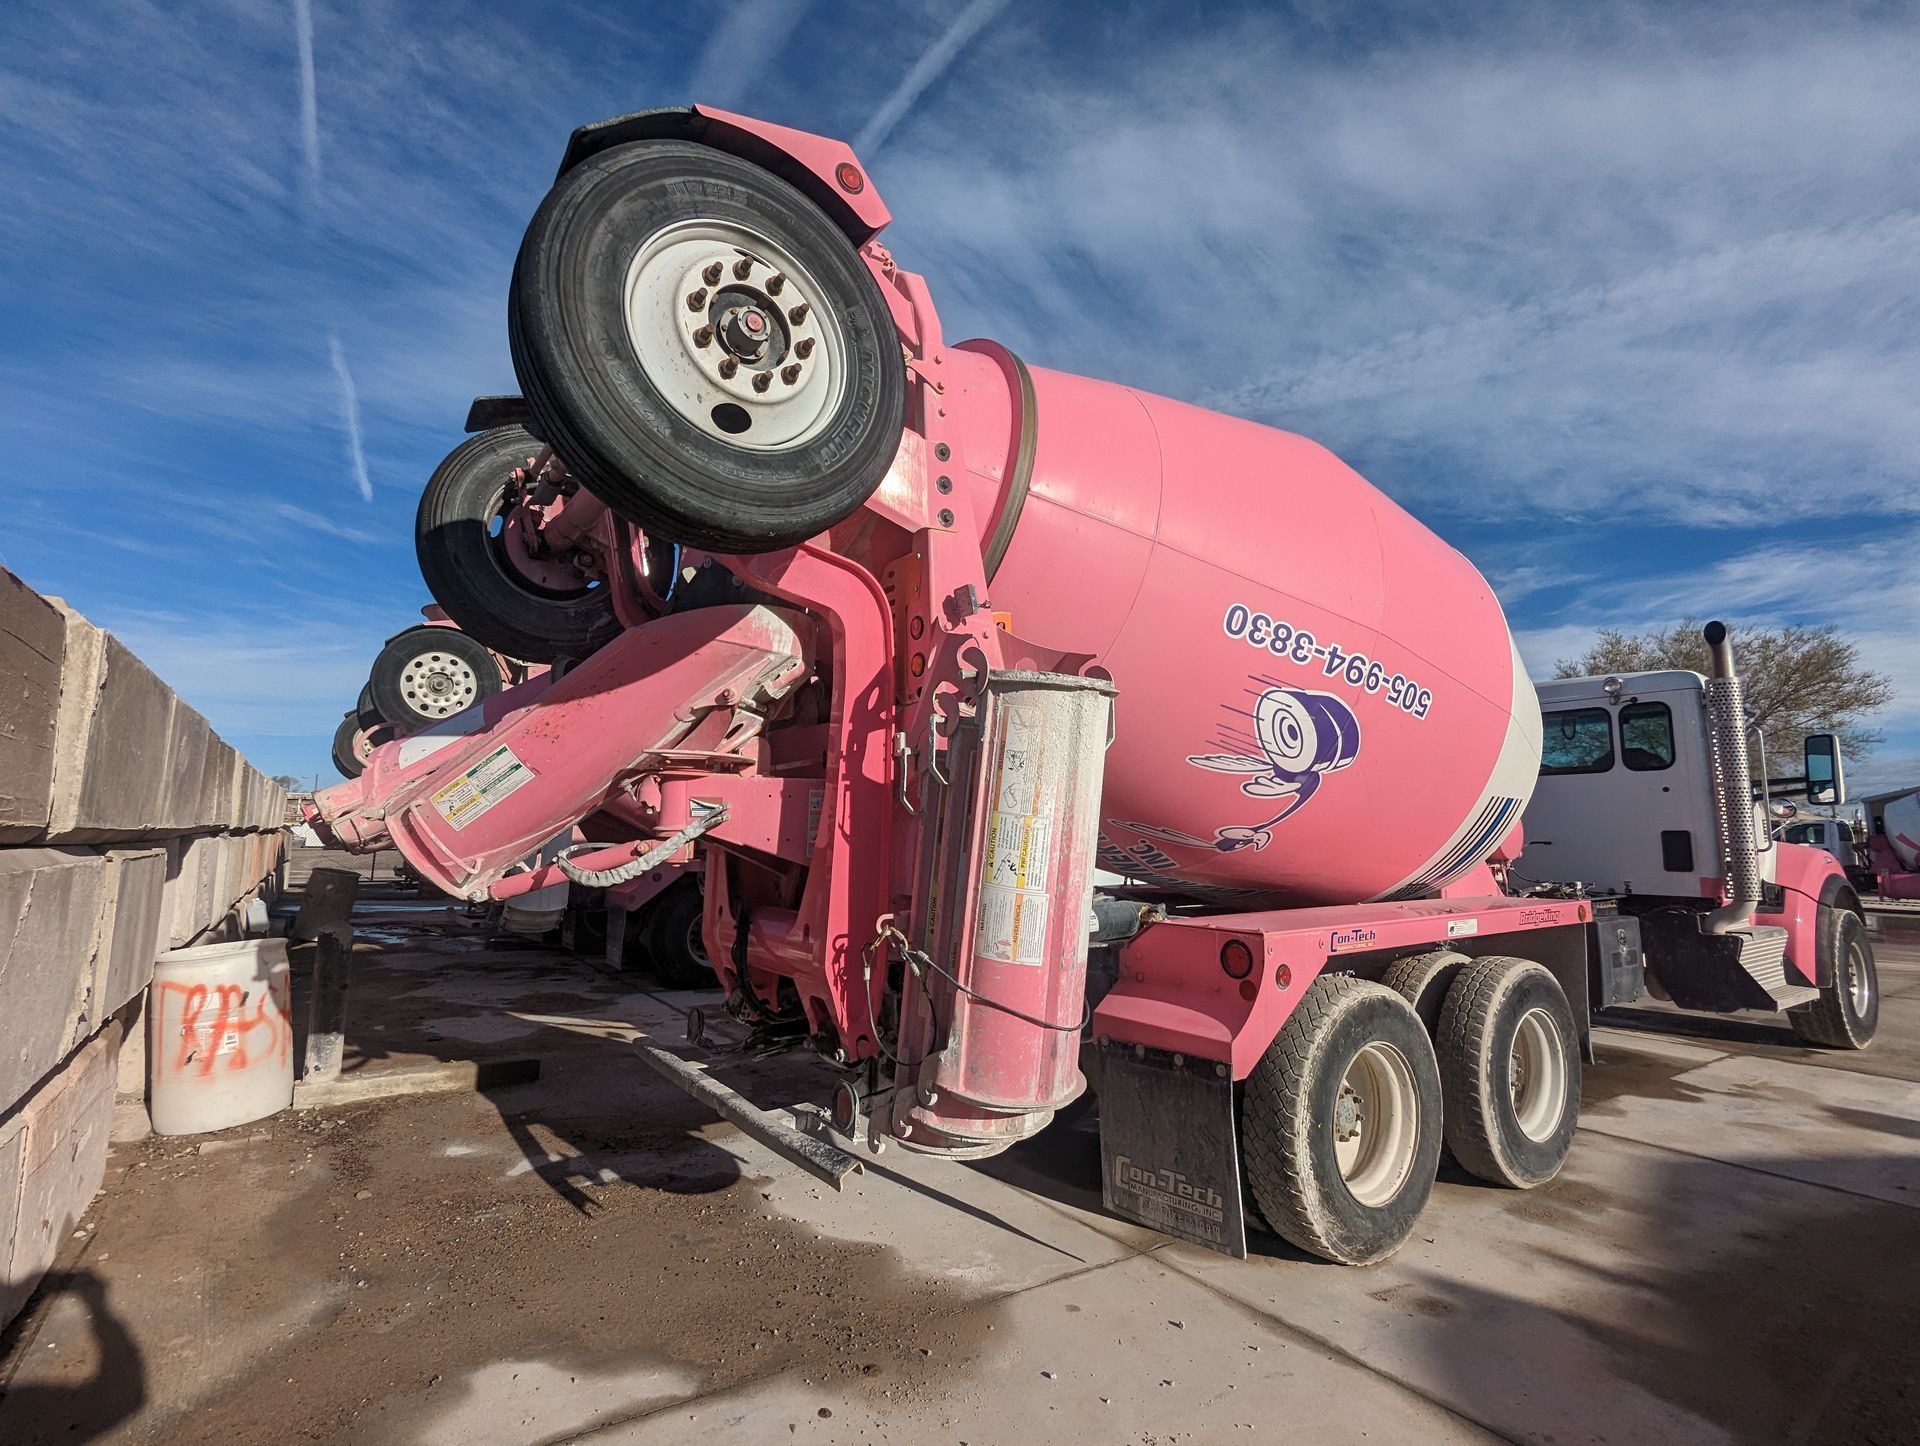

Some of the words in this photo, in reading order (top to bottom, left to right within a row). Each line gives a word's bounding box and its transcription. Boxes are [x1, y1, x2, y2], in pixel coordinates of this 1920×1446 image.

[819, 348, 880, 467] MICHELIN
[1223, 604, 1432, 719] 505-994-3830
[988, 827, 997, 860] CAUTION
[1127, 839, 1179, 870] INC.
[929, 896, 937, 927] CAUTION
[1519, 908, 1560, 926] BridgeKing
[1330, 929, 1376, 952] Con-Tech
[1115, 1154, 1222, 1209] Con-Tech
